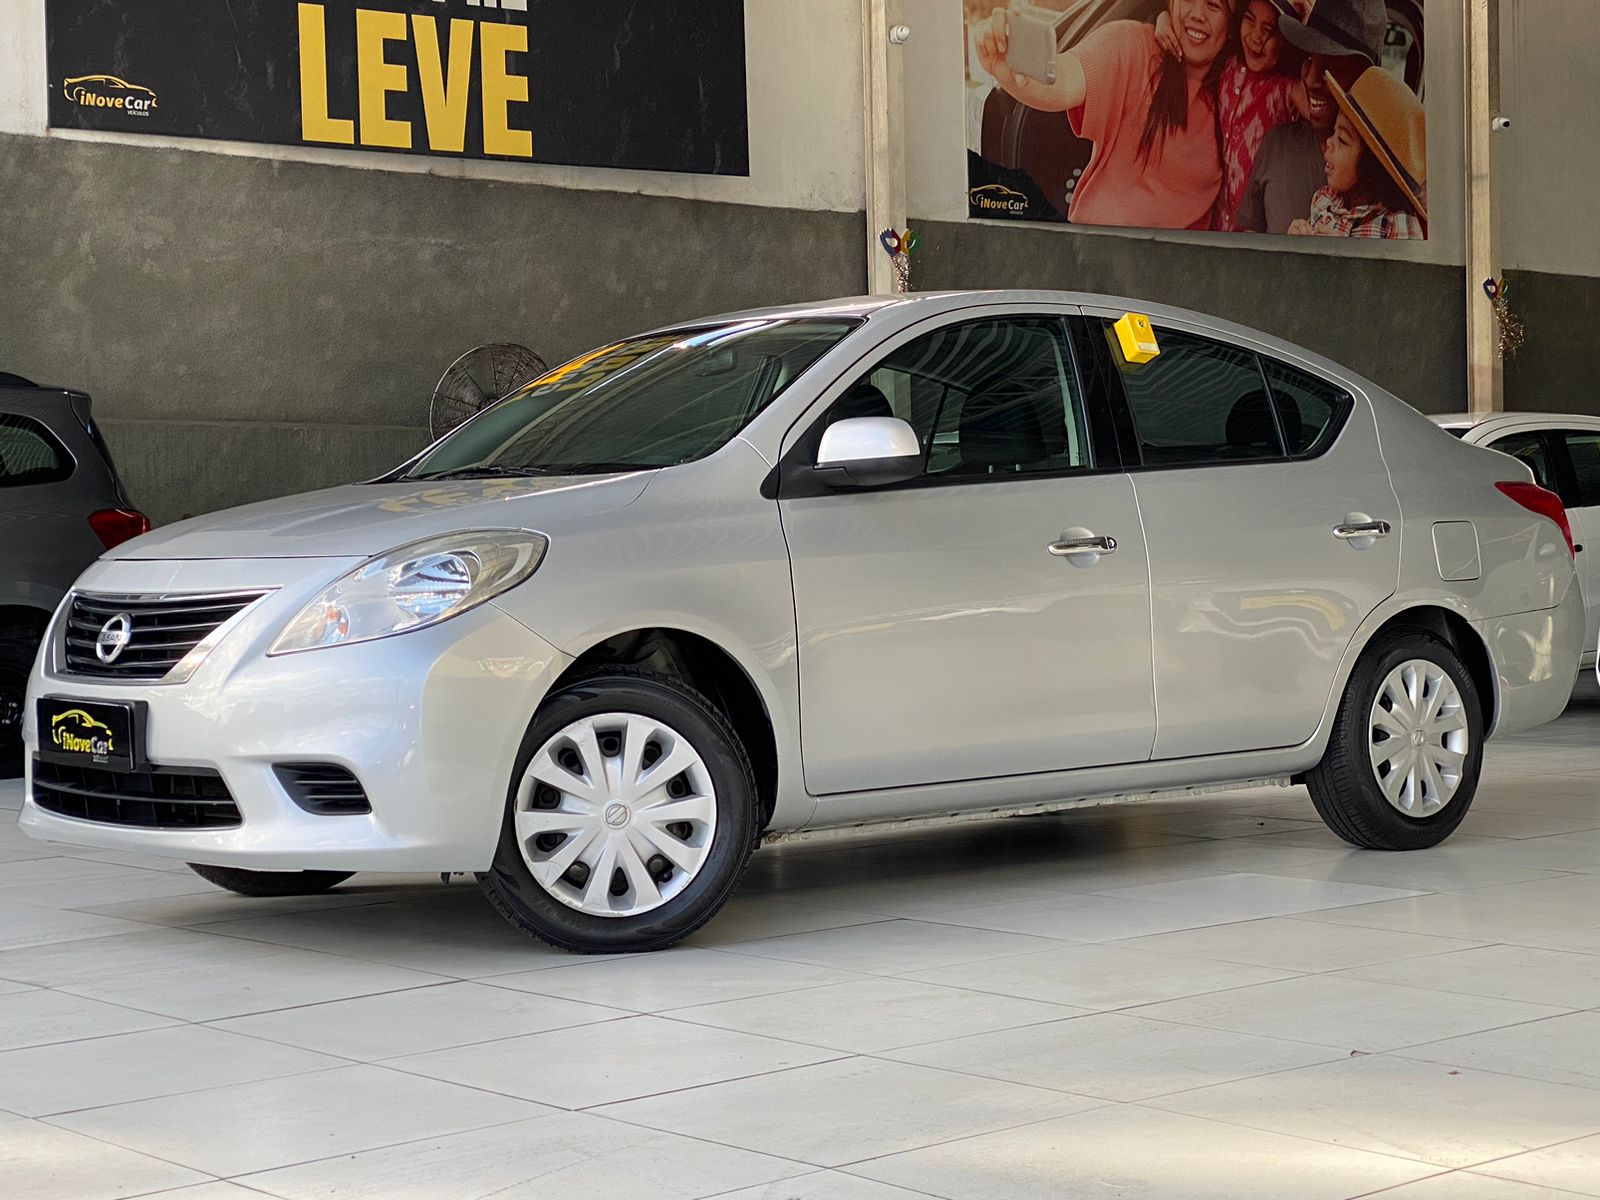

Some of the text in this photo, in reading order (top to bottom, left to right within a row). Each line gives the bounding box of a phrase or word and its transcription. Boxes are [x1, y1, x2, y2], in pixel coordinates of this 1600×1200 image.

[298, 2, 533, 157] LEVE
[80, 91, 151, 110] iNoveCar
[980, 196, 1025, 210] iNoveCar
[63, 732, 108, 754] iNoveCar
